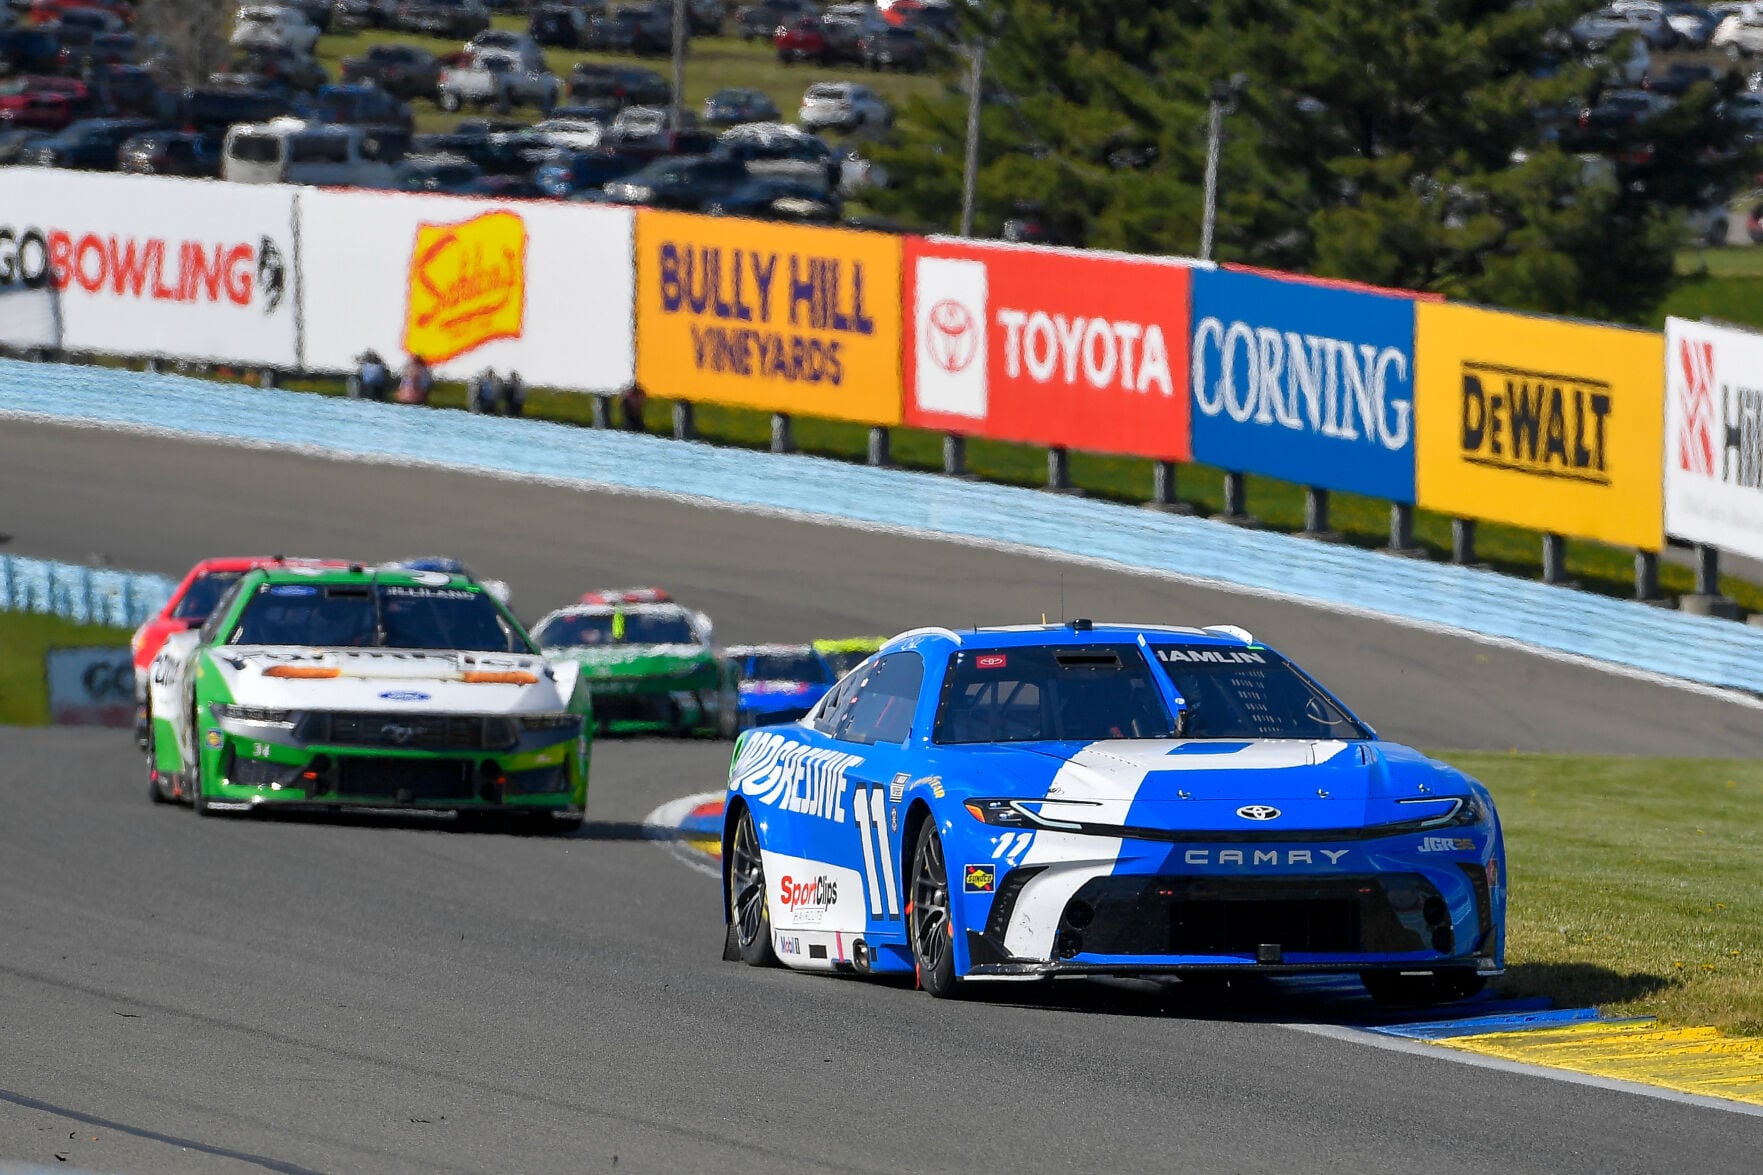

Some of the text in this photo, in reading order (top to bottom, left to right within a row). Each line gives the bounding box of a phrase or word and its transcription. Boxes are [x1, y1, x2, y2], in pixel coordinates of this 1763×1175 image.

[659, 241, 874, 335] BULLY HILL
[690, 322, 844, 386] VINEYARDS
[997, 307, 1174, 397] TOYOTA
[1192, 316, 1411, 451] CORNING
[253, 743, 270, 758] 34
[730, 731, 866, 823] PROGRESSIVE
[854, 783, 900, 921] 11
[991, 831, 1034, 860] 11
[1185, 850, 1349, 866] CAMRY
